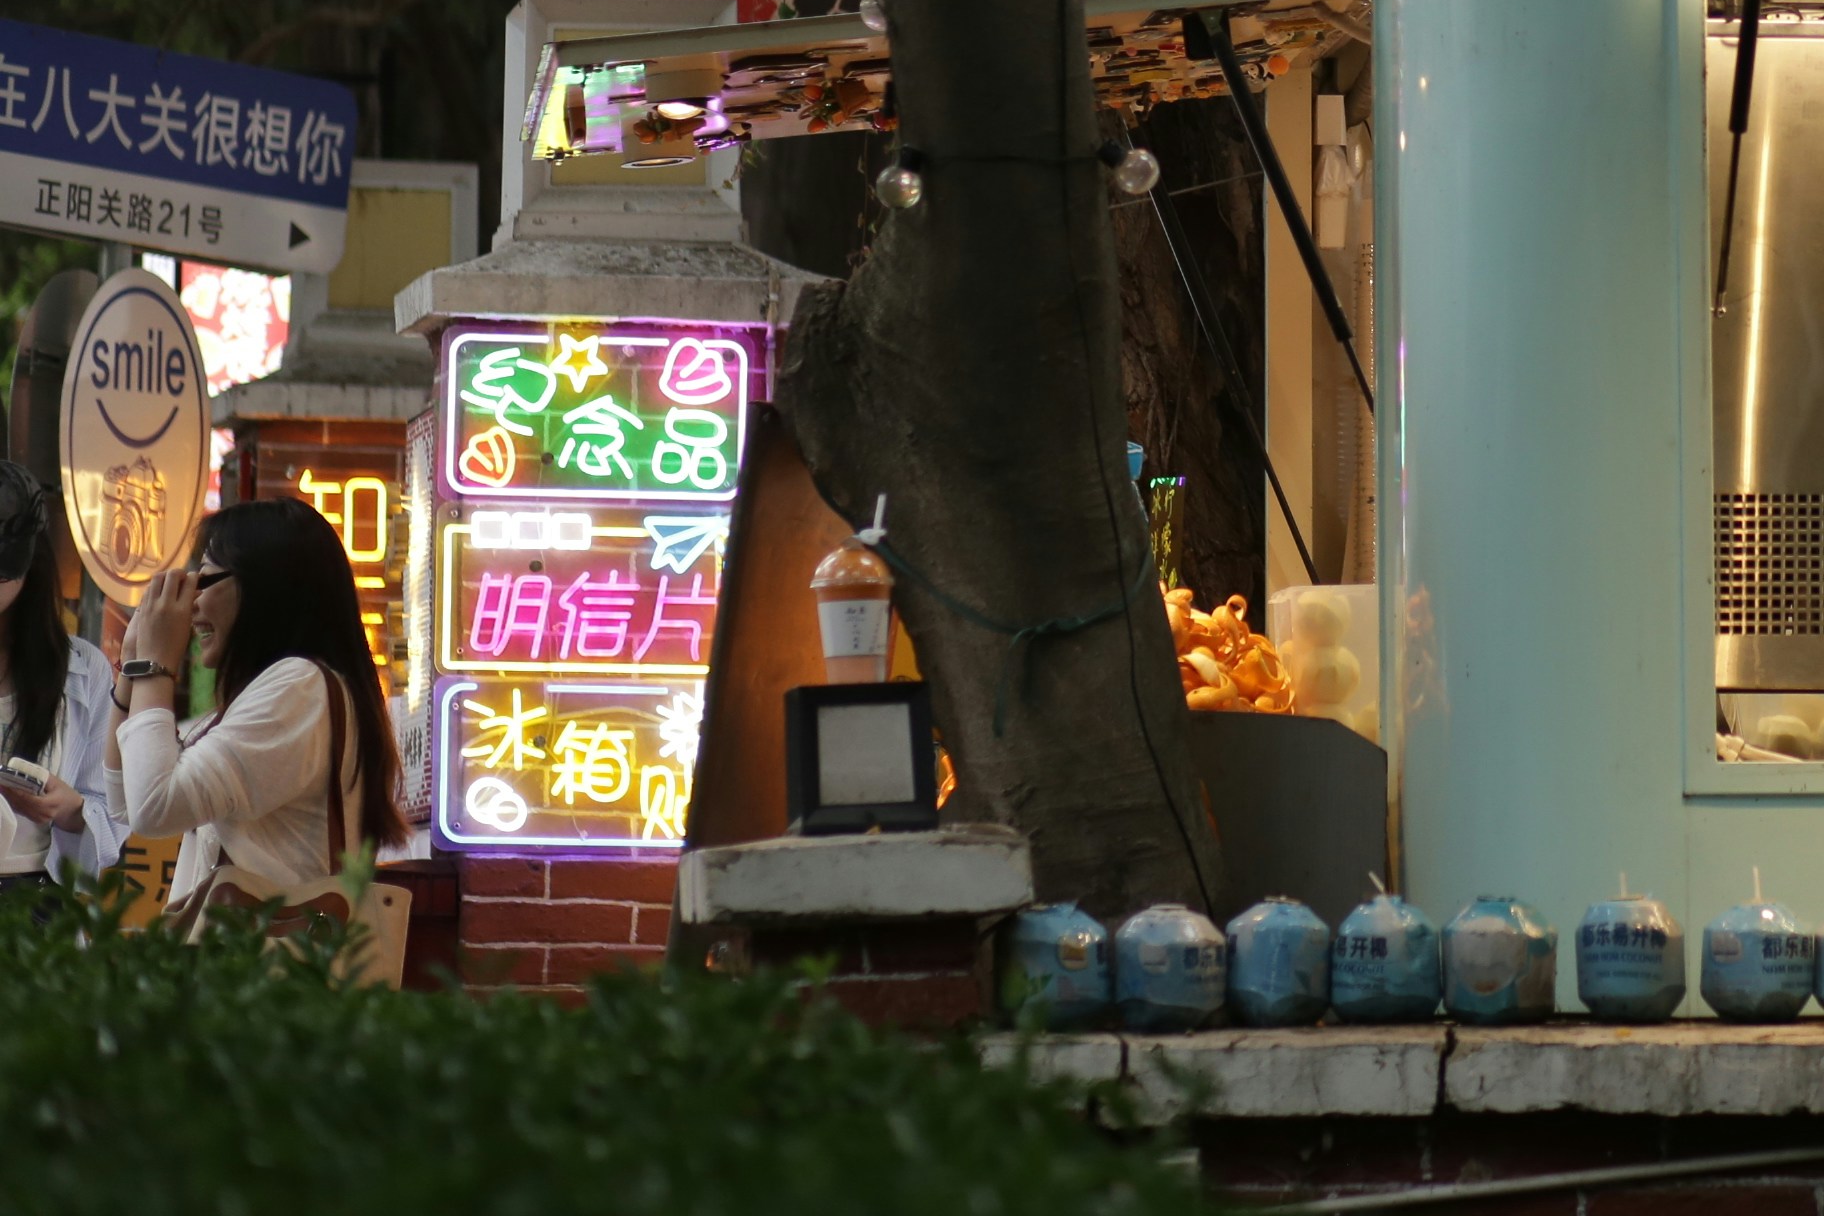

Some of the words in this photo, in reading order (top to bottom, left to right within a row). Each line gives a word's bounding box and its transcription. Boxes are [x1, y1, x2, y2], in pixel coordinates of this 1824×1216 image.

[0, 52, 347, 185] 在八大关很想你
[34, 177, 224, 245] 正阳关路21号
[91, 328, 186, 397] smile
[460, 346, 728, 490] 纪念品
[470, 568, 718, 662] 明信片
[461, 687, 692, 841] 冰箱贴
